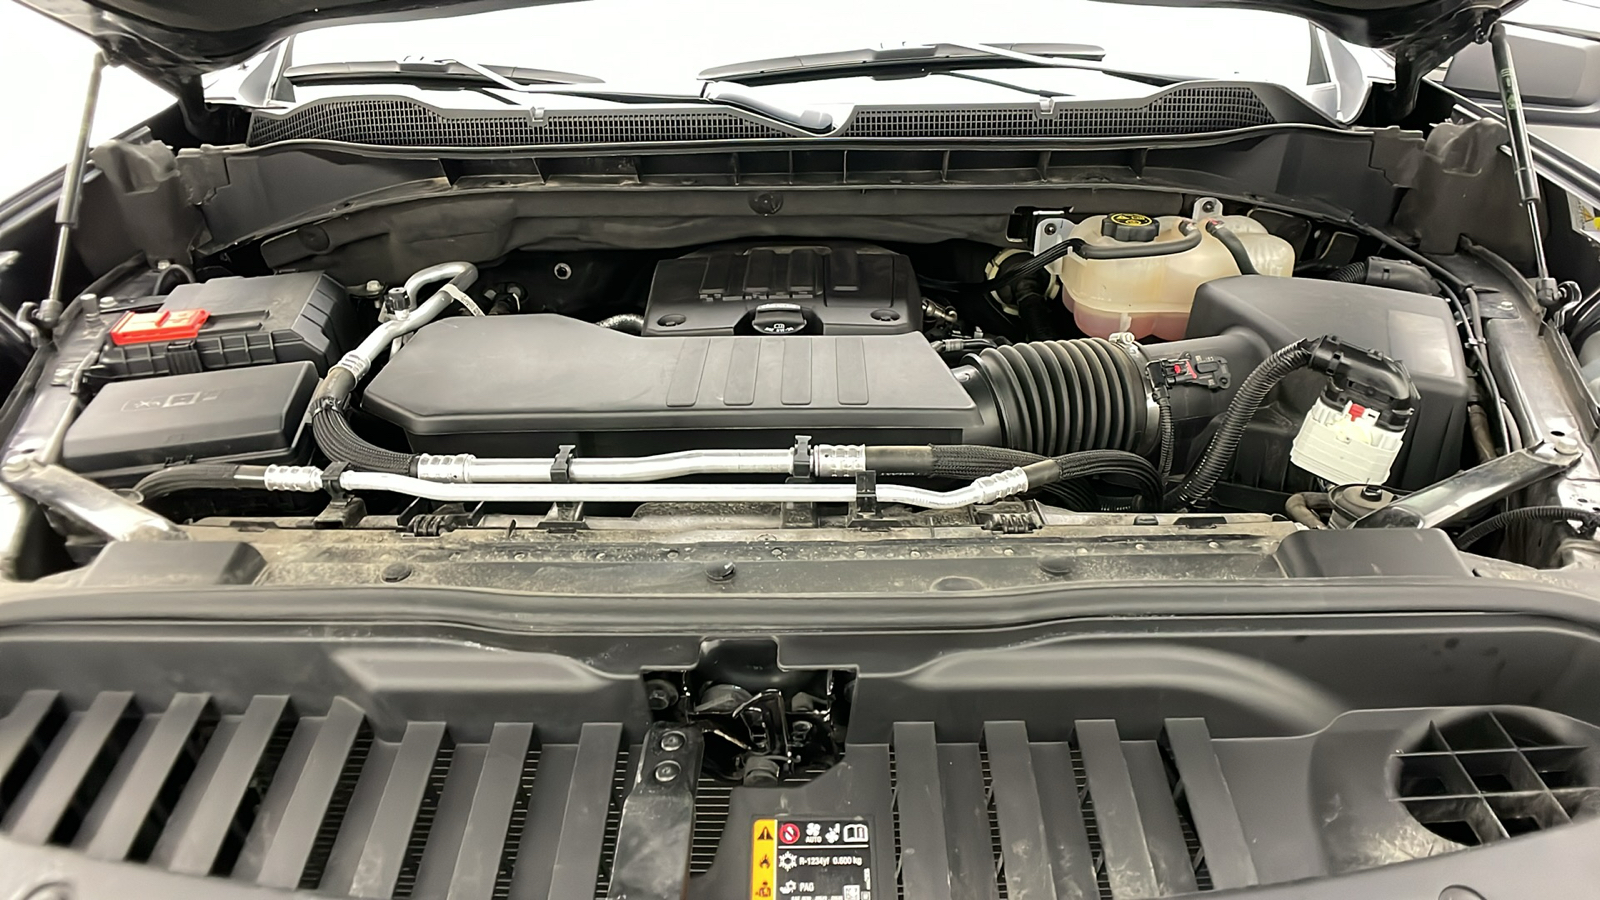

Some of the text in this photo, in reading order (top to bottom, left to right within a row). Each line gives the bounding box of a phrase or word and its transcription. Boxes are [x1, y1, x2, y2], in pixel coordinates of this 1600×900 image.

[799, 856, 862, 866] R-1234yf 0.600 kg
[799, 882, 814, 892] PAG
